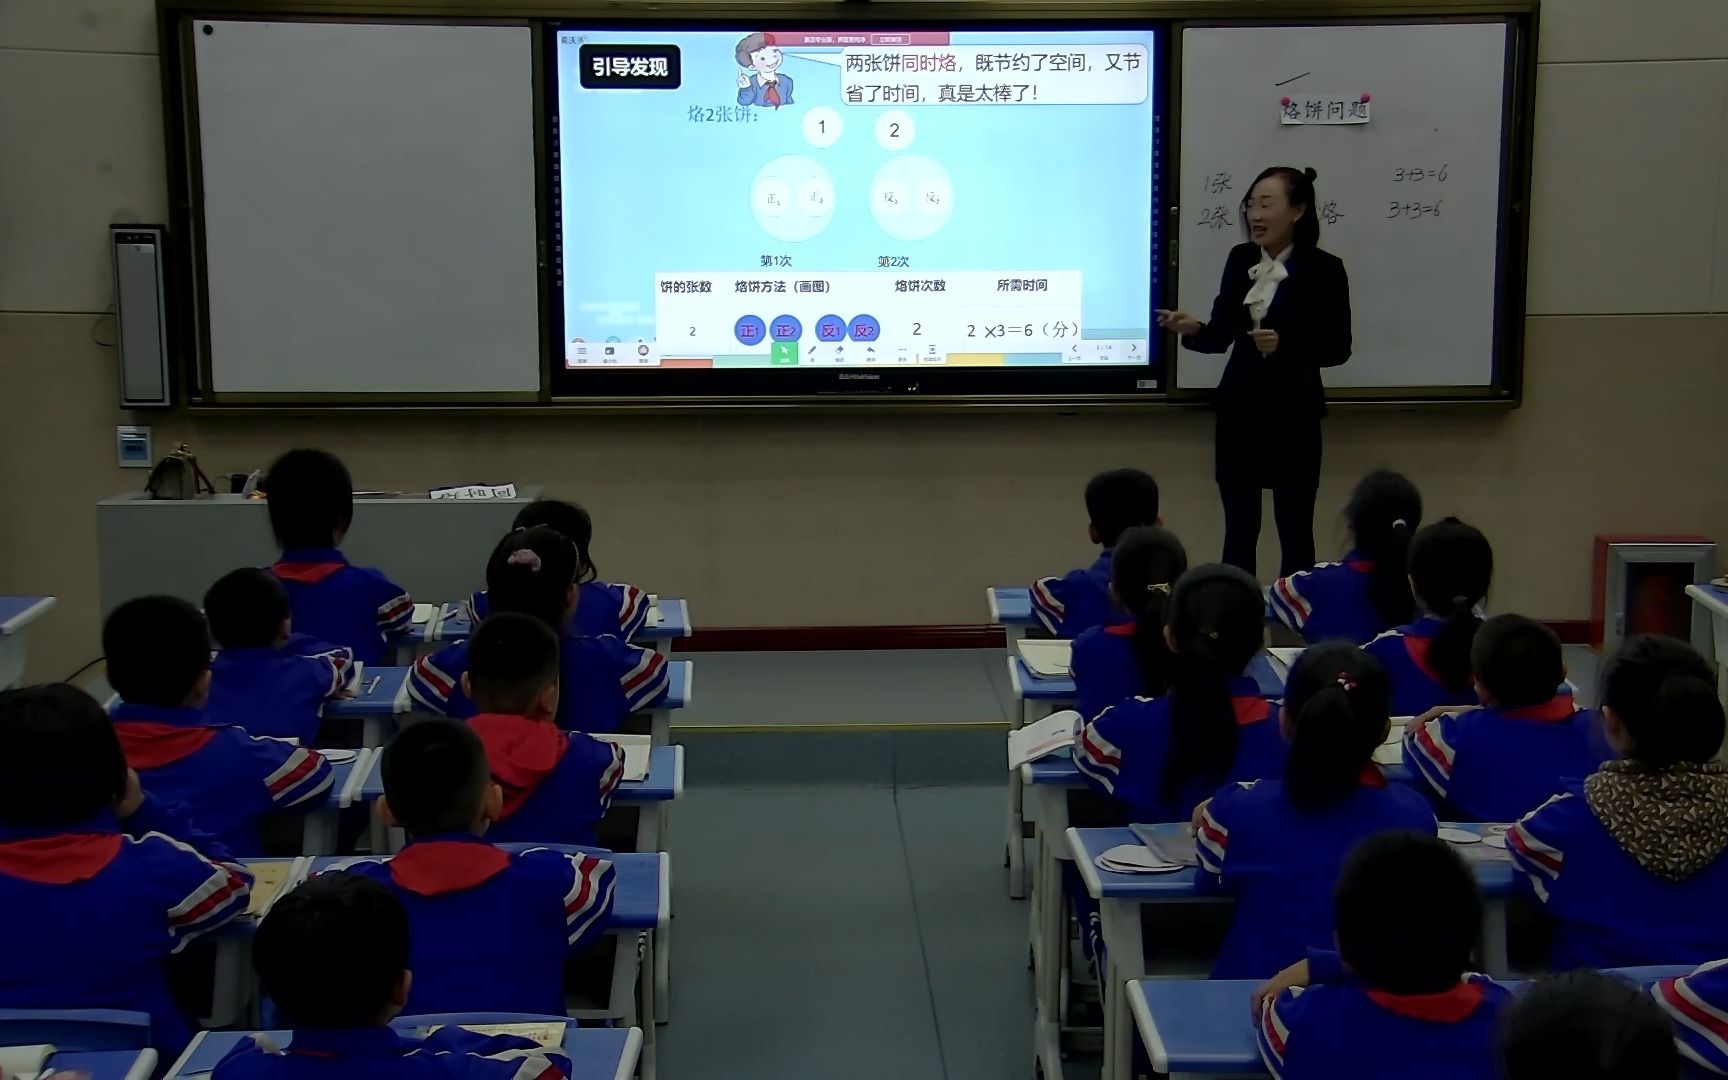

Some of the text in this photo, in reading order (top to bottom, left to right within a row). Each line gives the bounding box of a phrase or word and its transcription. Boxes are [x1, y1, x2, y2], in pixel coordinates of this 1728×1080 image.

[592, 56, 669, 77] 引导发现
[1282, 101, 1368, 121] 烙饼问题
[818, 120, 826, 134] 1
[889, 123, 900, 137] 2
[1392, 164, 1448, 182] 3+3=6
[1386, 200, 1444, 220] 3+3=6
[760, 255, 793, 268] 第1次
[877, 255, 910, 268] 第2次
[660, 280, 712, 294] 饼的张数
[895, 279, 946, 293] 烙饼次数
[997, 278, 1048, 292] 所需时间
[689, 326, 697, 337] 2
[741, 325, 759, 338] 正1
[775, 325, 796, 338] 正2
[822, 324, 840, 337] 反1
[855, 324, 874, 337] 反2
[912, 322, 922, 336] 2
